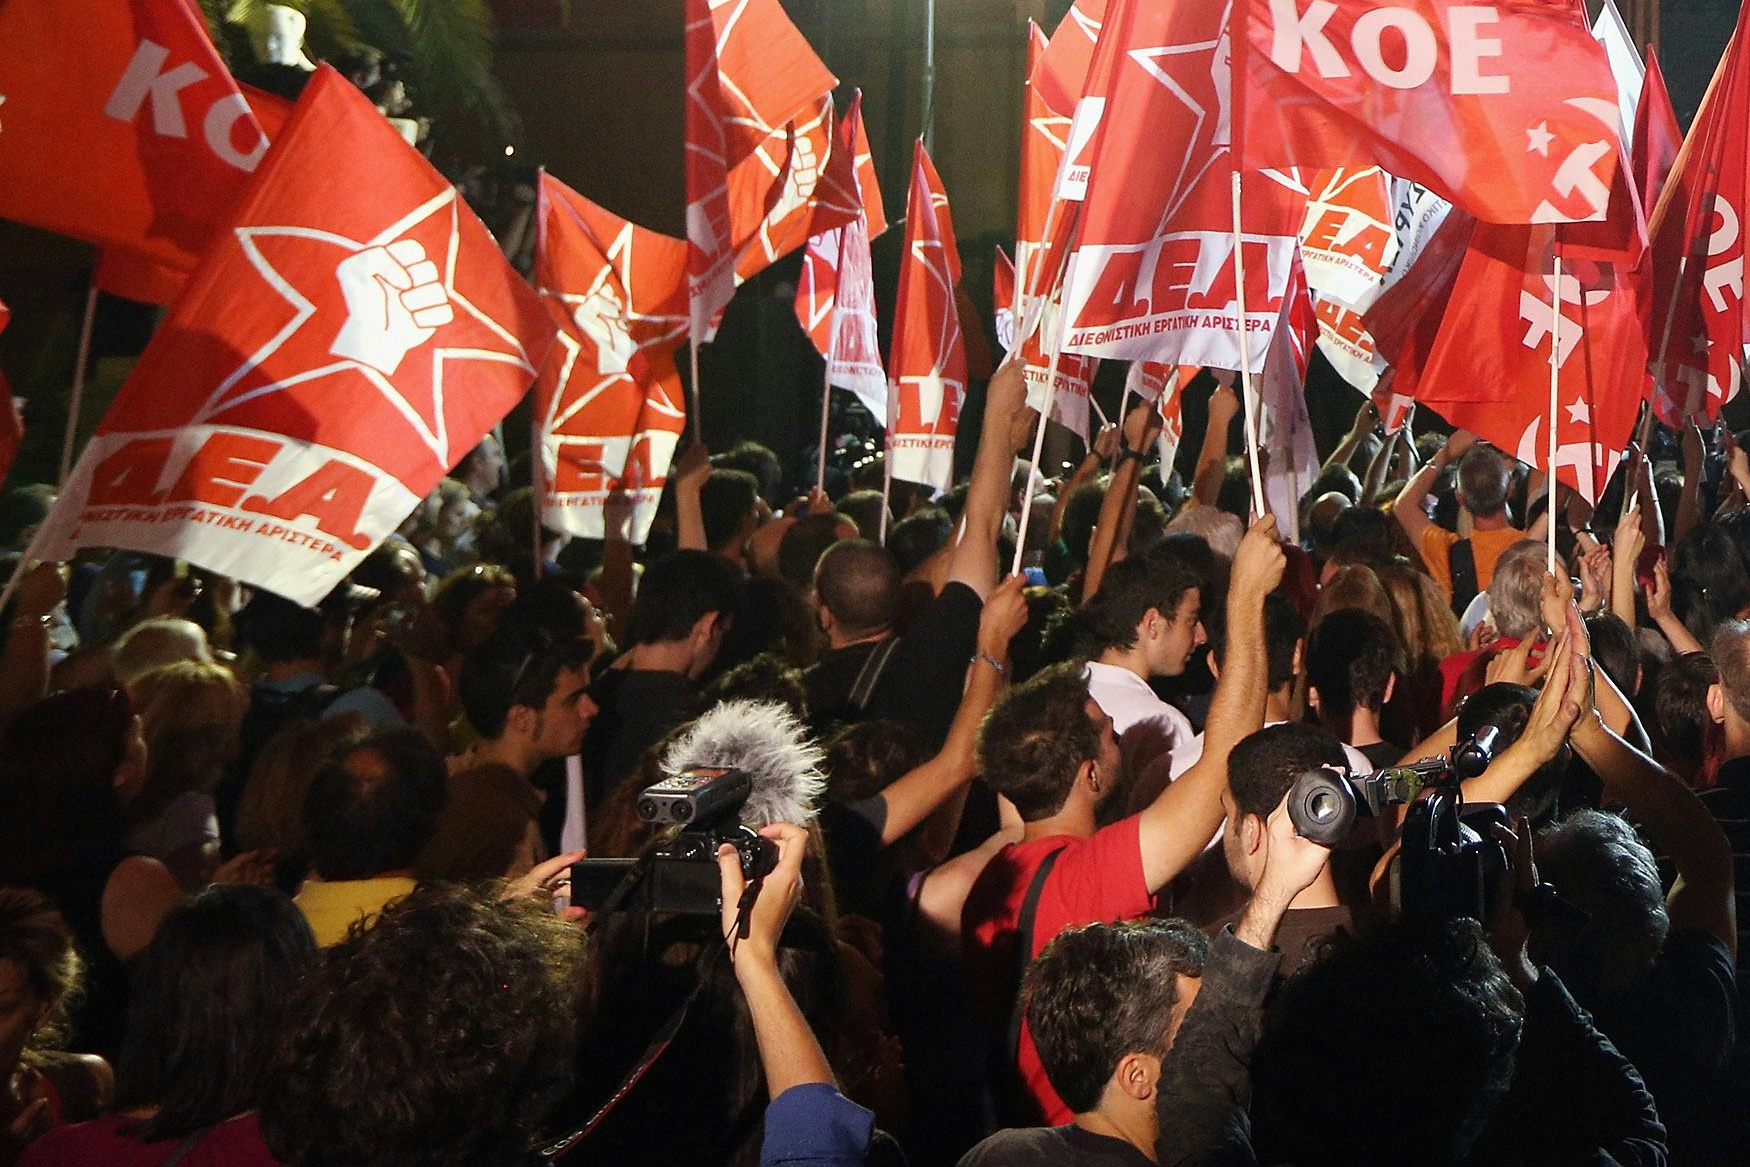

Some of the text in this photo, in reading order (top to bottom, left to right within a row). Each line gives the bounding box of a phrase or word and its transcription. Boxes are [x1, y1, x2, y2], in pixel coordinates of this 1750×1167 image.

[1067, 322, 1150, 347] ΔΙΕΘΝΙΣΤΙΚΗ
[1153, 315, 1199, 334] ΕΡΓΑΤΙΚΗ
[256, 520, 345, 563] ΑΡΙΣΤΕΡΑ
